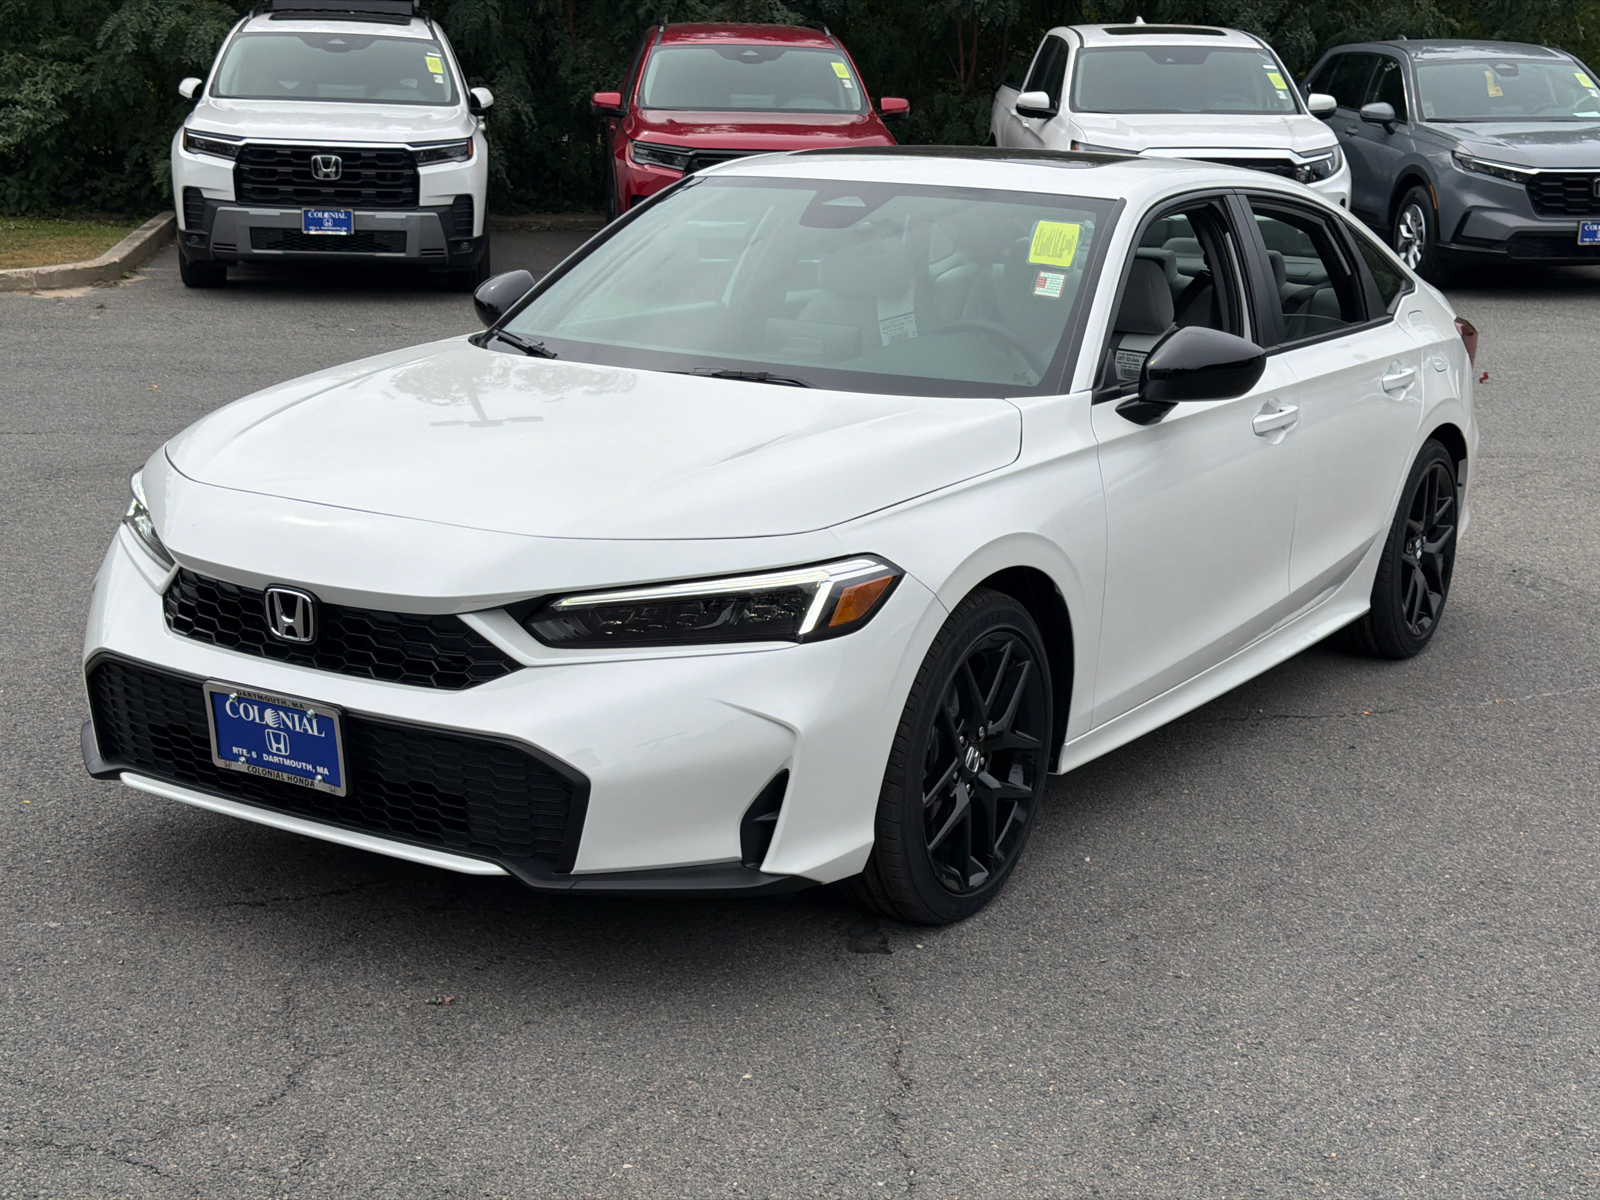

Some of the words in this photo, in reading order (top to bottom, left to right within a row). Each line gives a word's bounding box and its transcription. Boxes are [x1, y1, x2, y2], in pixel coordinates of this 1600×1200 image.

[308, 211, 348, 219] COLONIAL
[236, 690, 290, 707] DARTMOUTH,
[291, 701, 305, 710] MA
[225, 700, 325, 738] COLONIAL
[232, 746, 251, 757] RTE.
[251, 750, 258, 759] 6
[262, 753, 316, 773] DARTMOUTH,
[316, 765, 330, 776] MA
[246, 765, 285, 781] COLONIAL
[287, 774, 315, 788] HONDA
